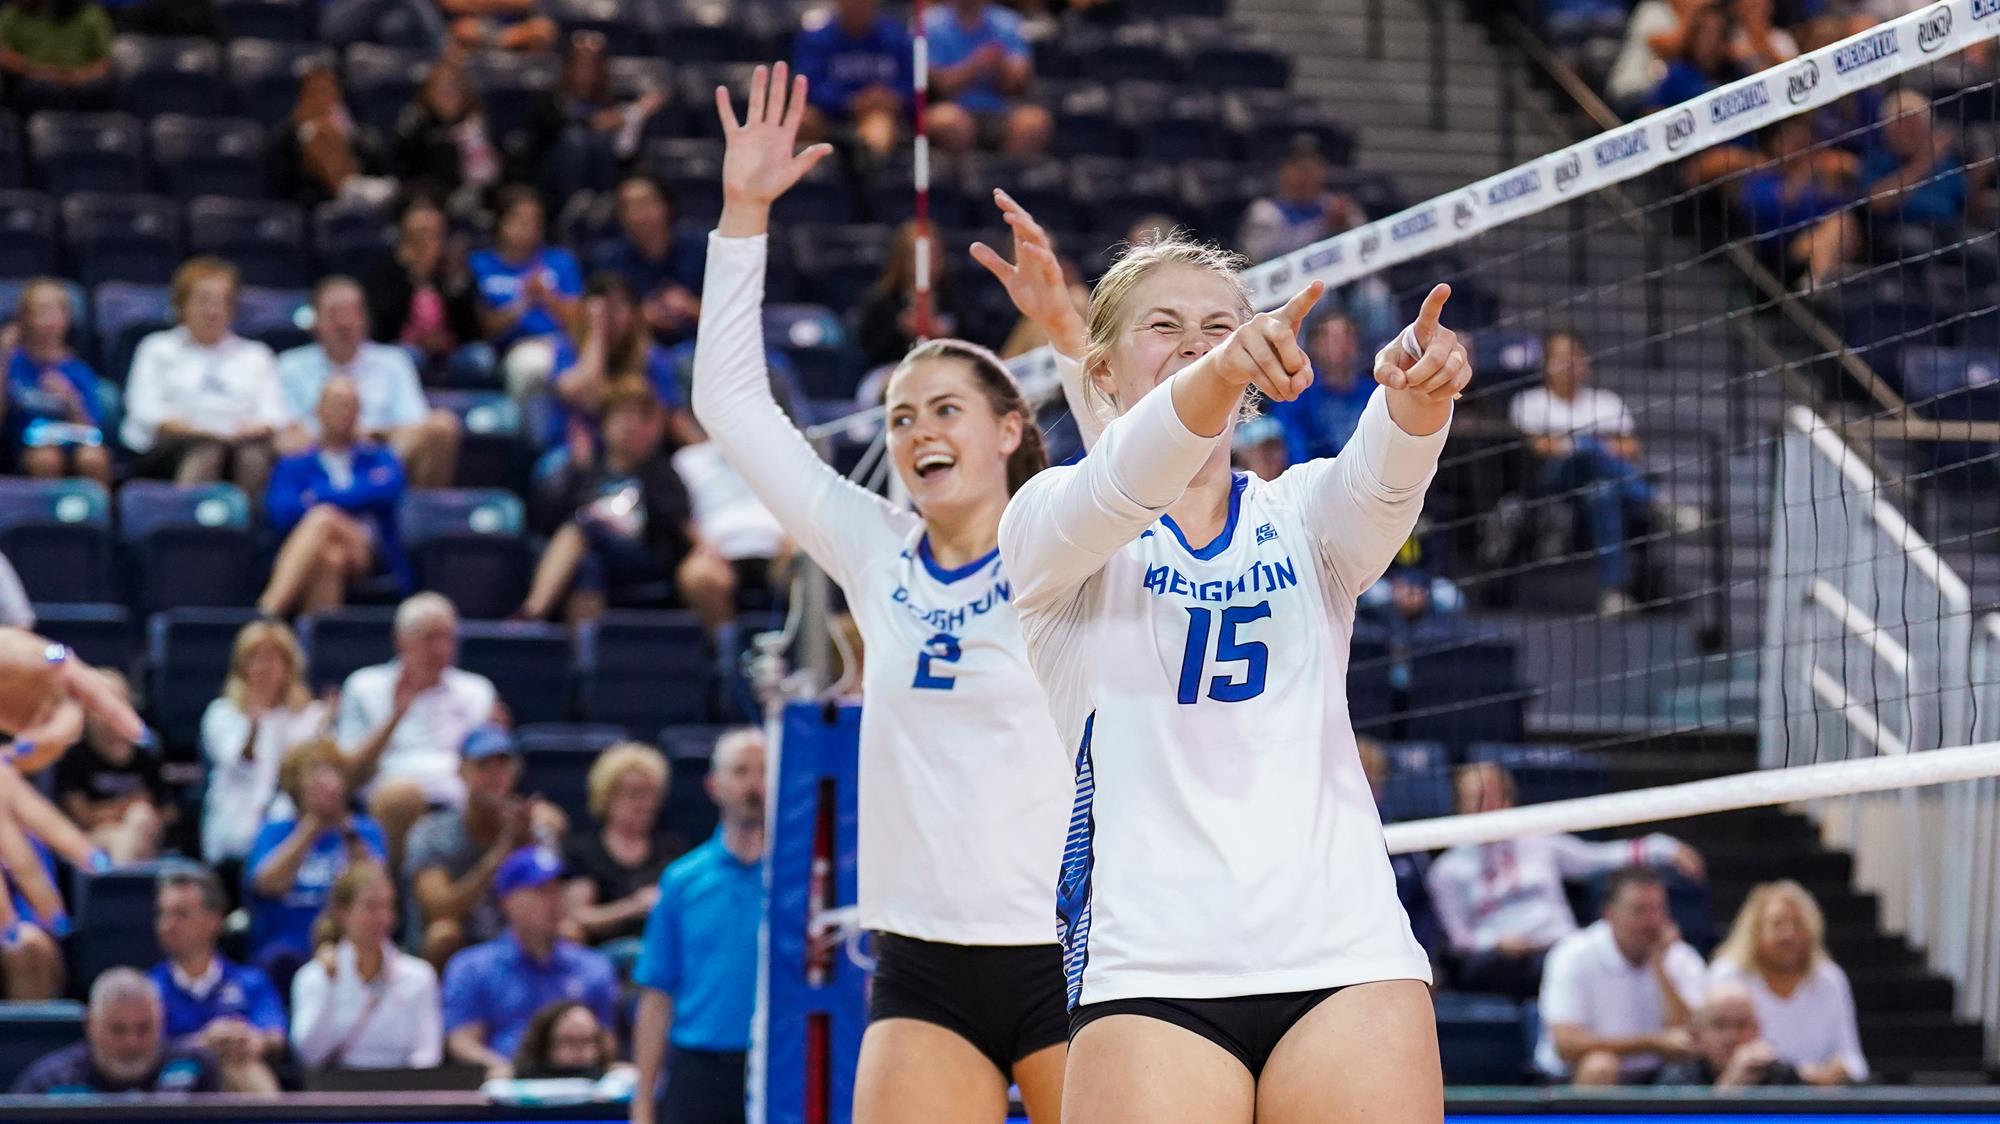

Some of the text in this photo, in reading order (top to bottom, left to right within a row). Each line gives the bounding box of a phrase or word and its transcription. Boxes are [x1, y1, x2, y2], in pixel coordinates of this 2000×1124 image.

[1833, 28, 1899, 75] CREIGHTON
[1255, 521, 1273, 537] IG
[911, 632, 963, 690] 2
[1177, 600, 1272, 705] 15
